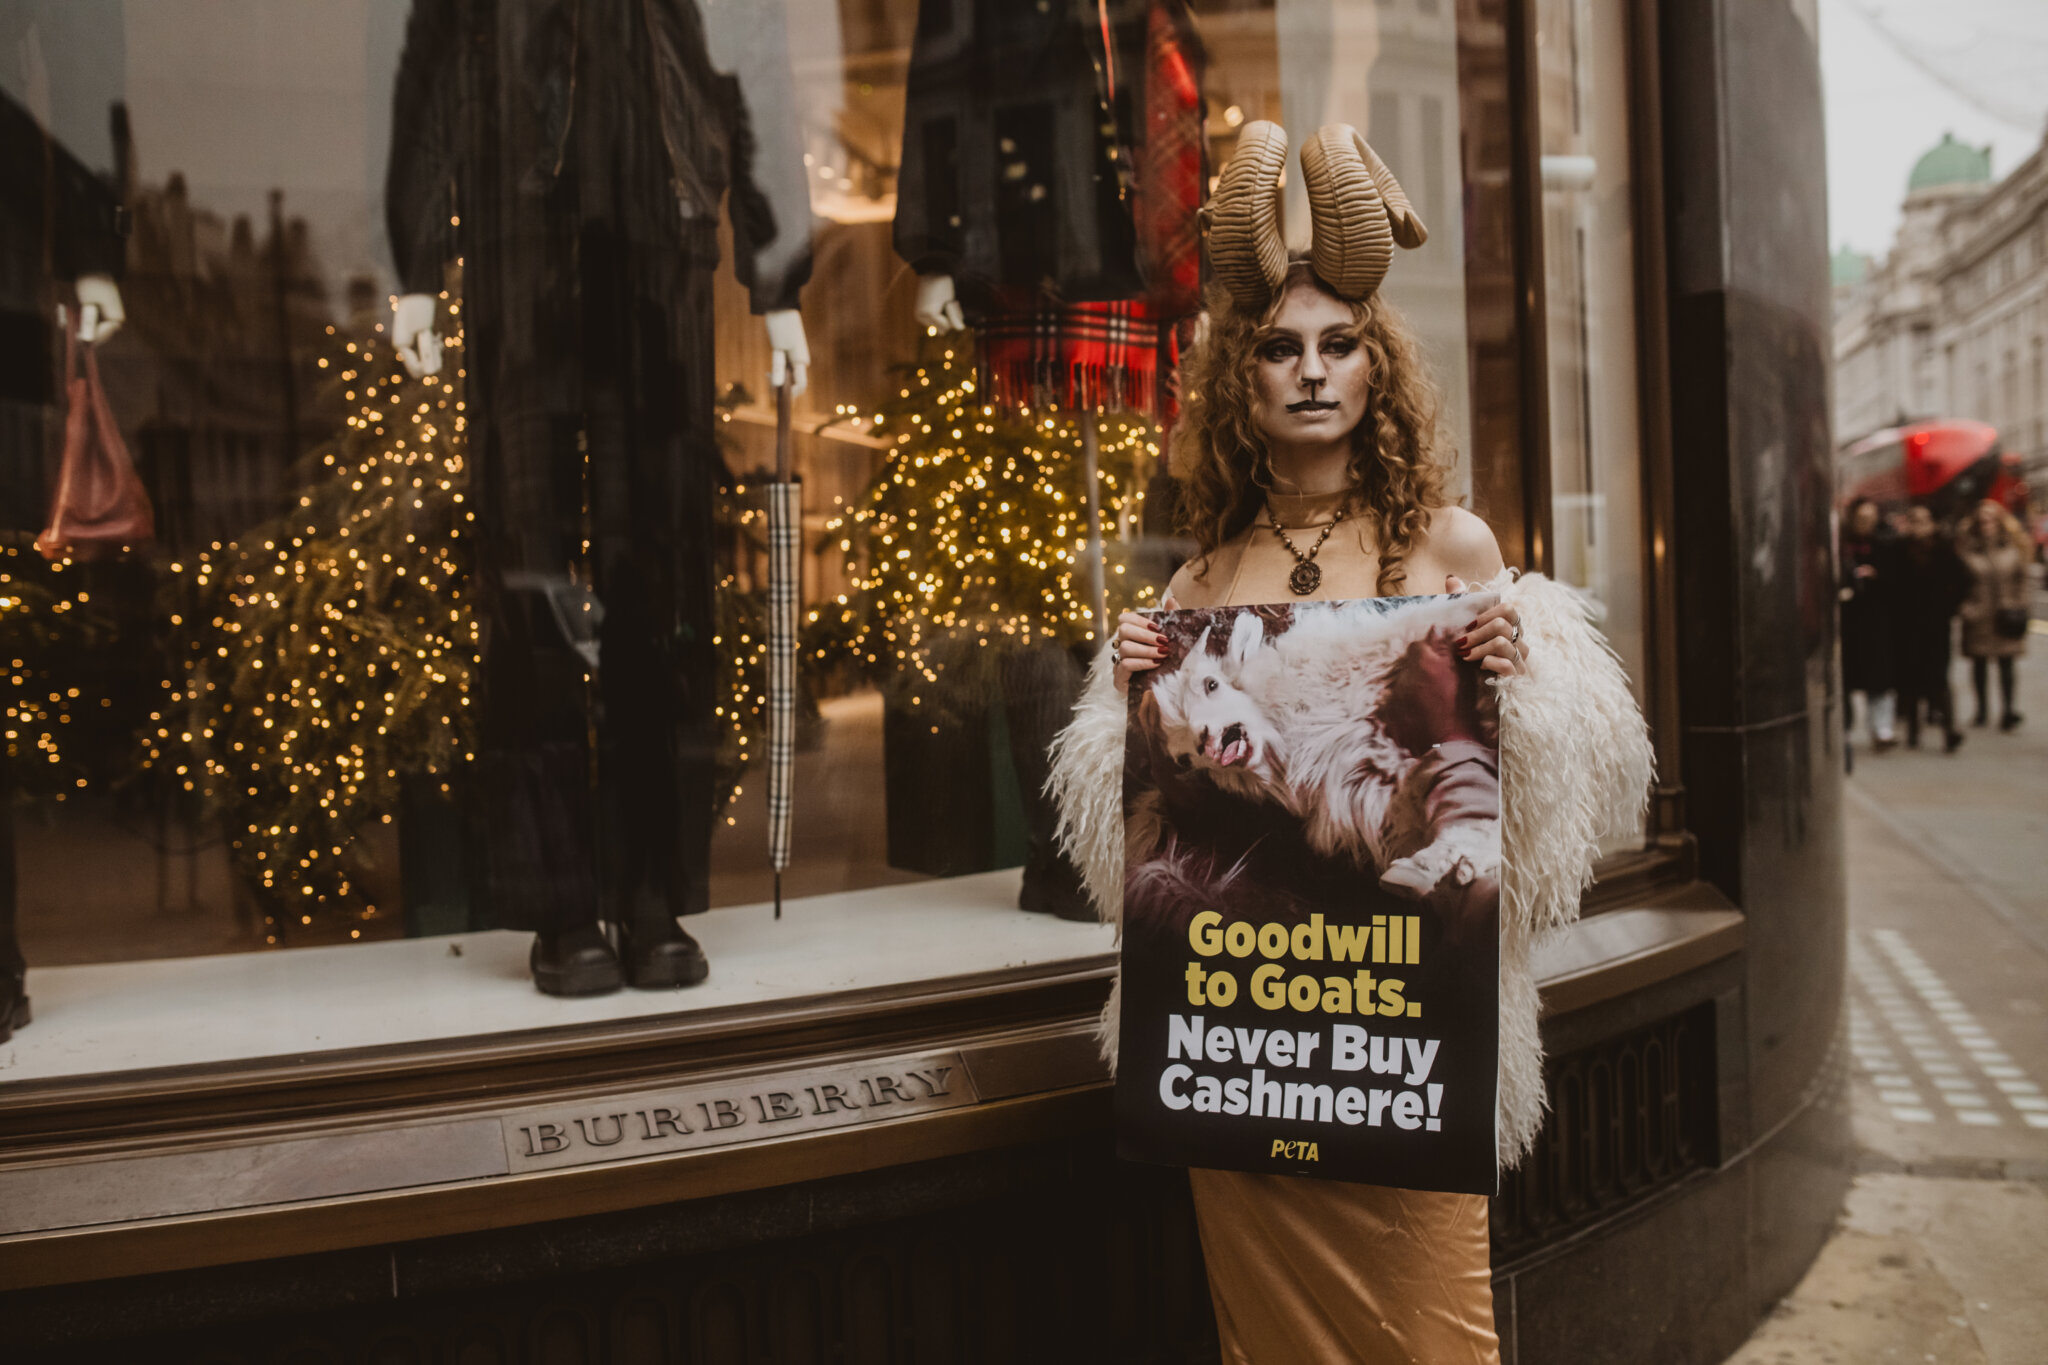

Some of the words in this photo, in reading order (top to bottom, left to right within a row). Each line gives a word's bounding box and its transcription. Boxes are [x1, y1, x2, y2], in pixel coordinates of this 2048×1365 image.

[1188, 911, 1420, 964] Goodwill
[1185, 962, 1238, 1007] to
[1250, 963, 1422, 1018] Goats.
[1167, 1014, 1320, 1068] Never
[1331, 1023, 1441, 1085] Buy
[519, 1066, 952, 1158] BURBERRY
[1159, 1064, 1444, 1132] Cashmere!
